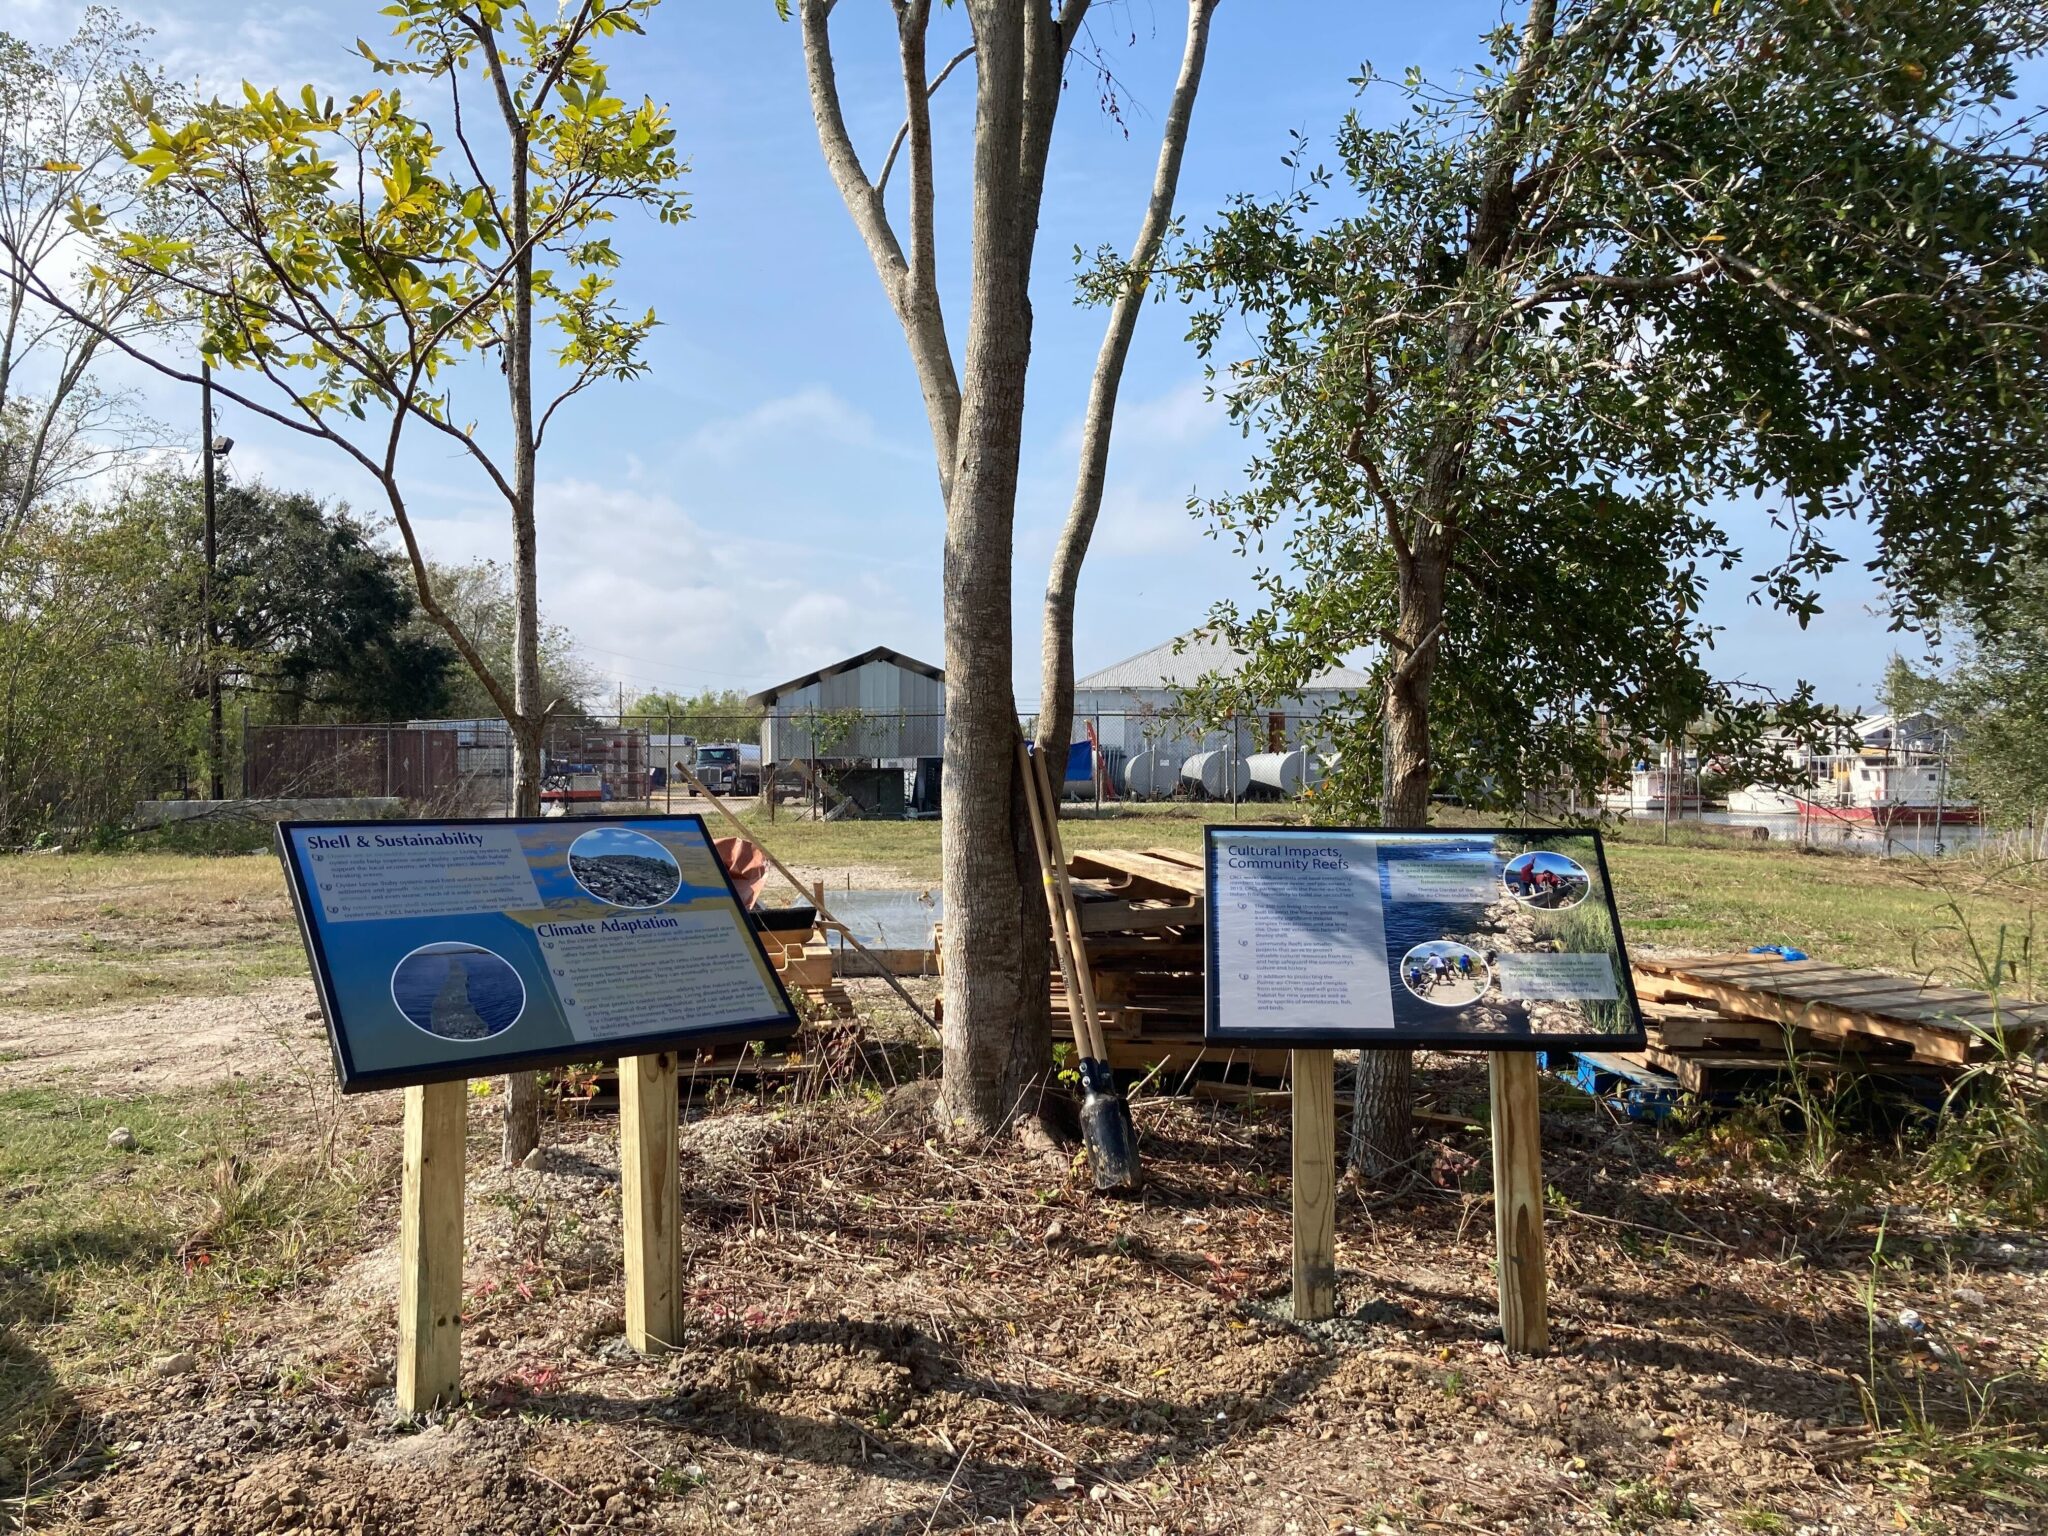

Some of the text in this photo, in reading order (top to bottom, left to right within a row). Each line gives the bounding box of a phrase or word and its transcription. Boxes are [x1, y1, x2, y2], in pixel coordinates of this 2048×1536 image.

[308, 832, 483, 849] Shell & Sustainability
[1229, 846, 1342, 858] Cultural Impacts,
[1229, 858, 1348, 871] Community Reefs
[538, 916, 678, 937] Climate Adaptation
